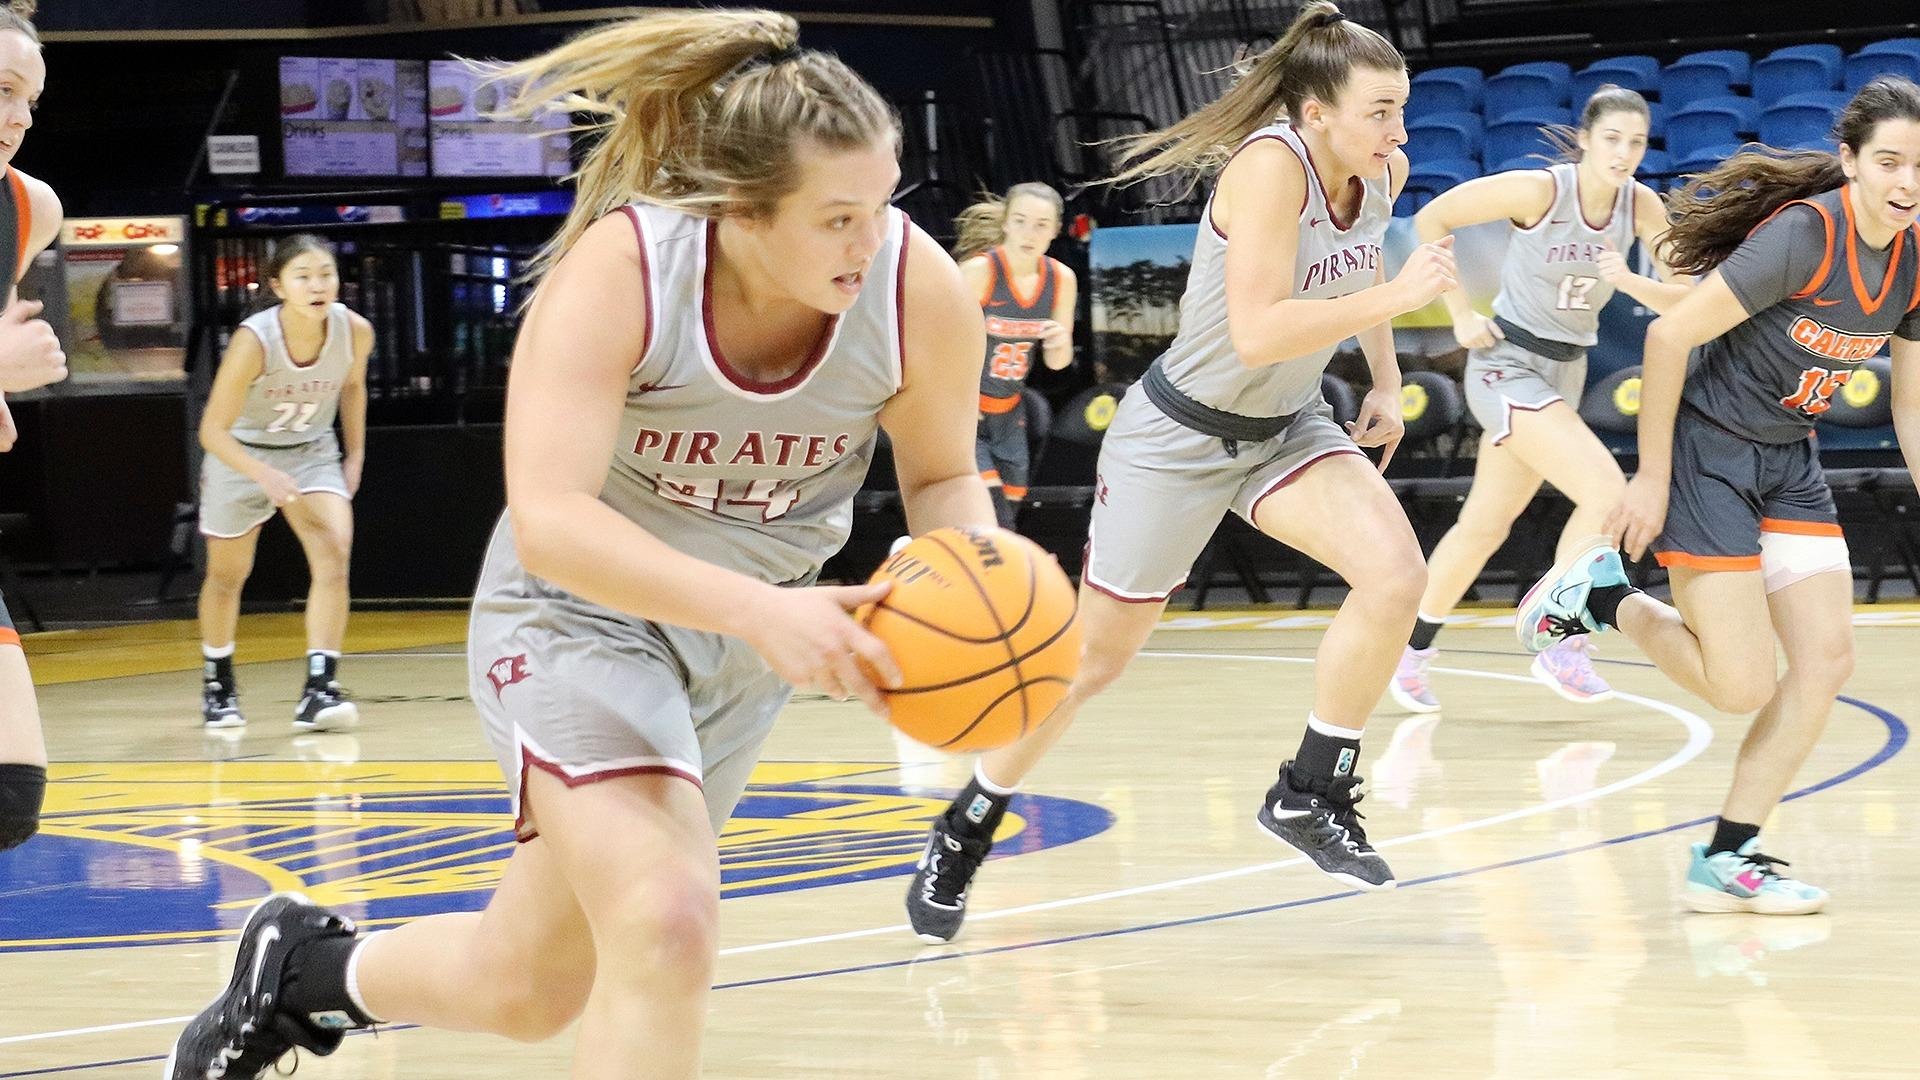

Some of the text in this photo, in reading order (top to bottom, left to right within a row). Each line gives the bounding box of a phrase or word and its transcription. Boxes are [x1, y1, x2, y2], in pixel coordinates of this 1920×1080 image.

[286, 122, 325, 138] Drinks
[1556, 273, 1599, 311] 12
[989, 341, 1034, 380] 25
[265, 400, 320, 433] 22
[632, 427, 849, 467] PIRATES
